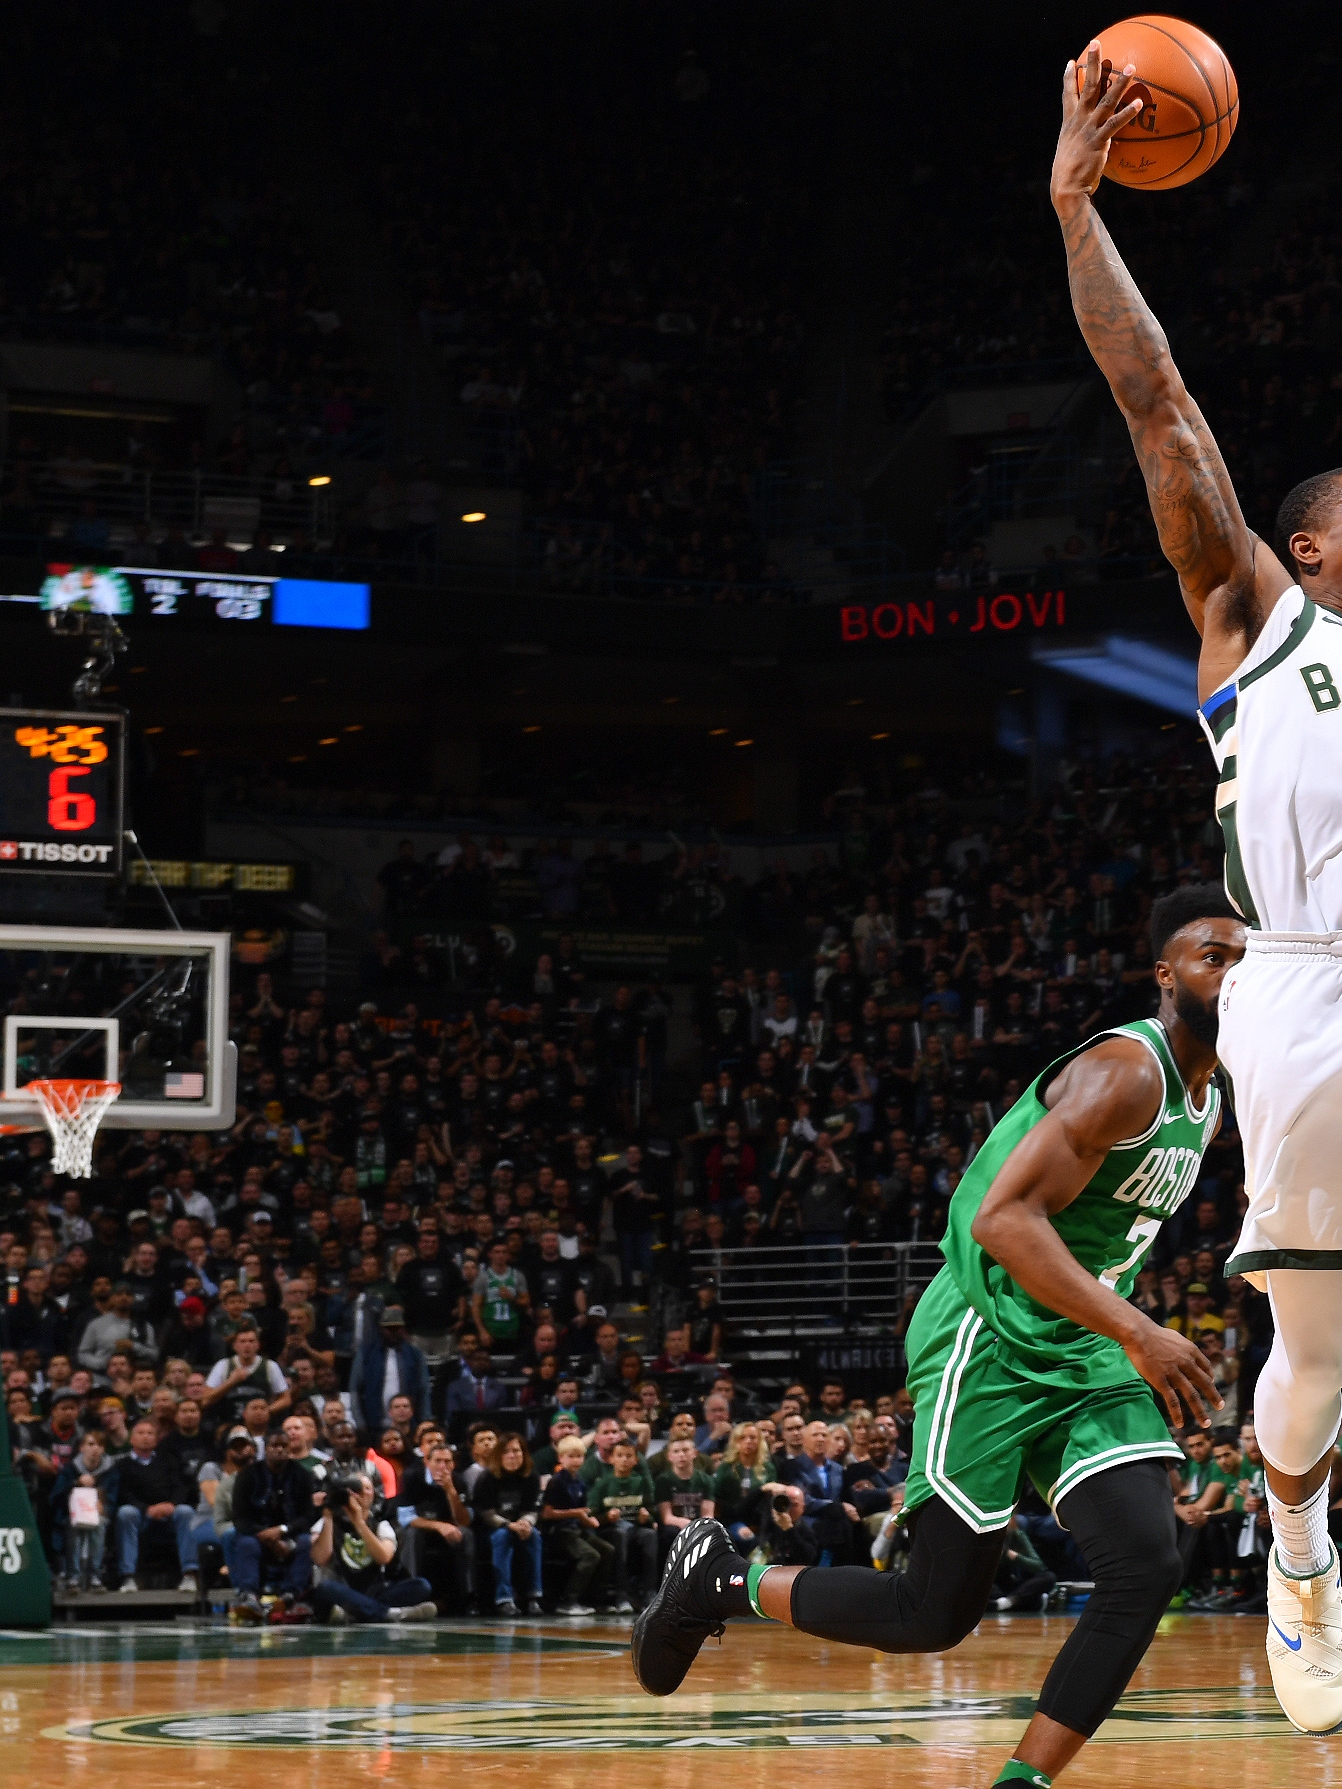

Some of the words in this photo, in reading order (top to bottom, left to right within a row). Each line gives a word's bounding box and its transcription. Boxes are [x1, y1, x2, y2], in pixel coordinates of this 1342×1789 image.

[150, 594, 178, 615] 2
[841, 600, 935, 641] BON
[969, 590, 1065, 631] JOVI
[48, 765, 97, 831] 6
[18, 841, 114, 863] TISSOT
[1098, 1215, 1163, 1291] 7
